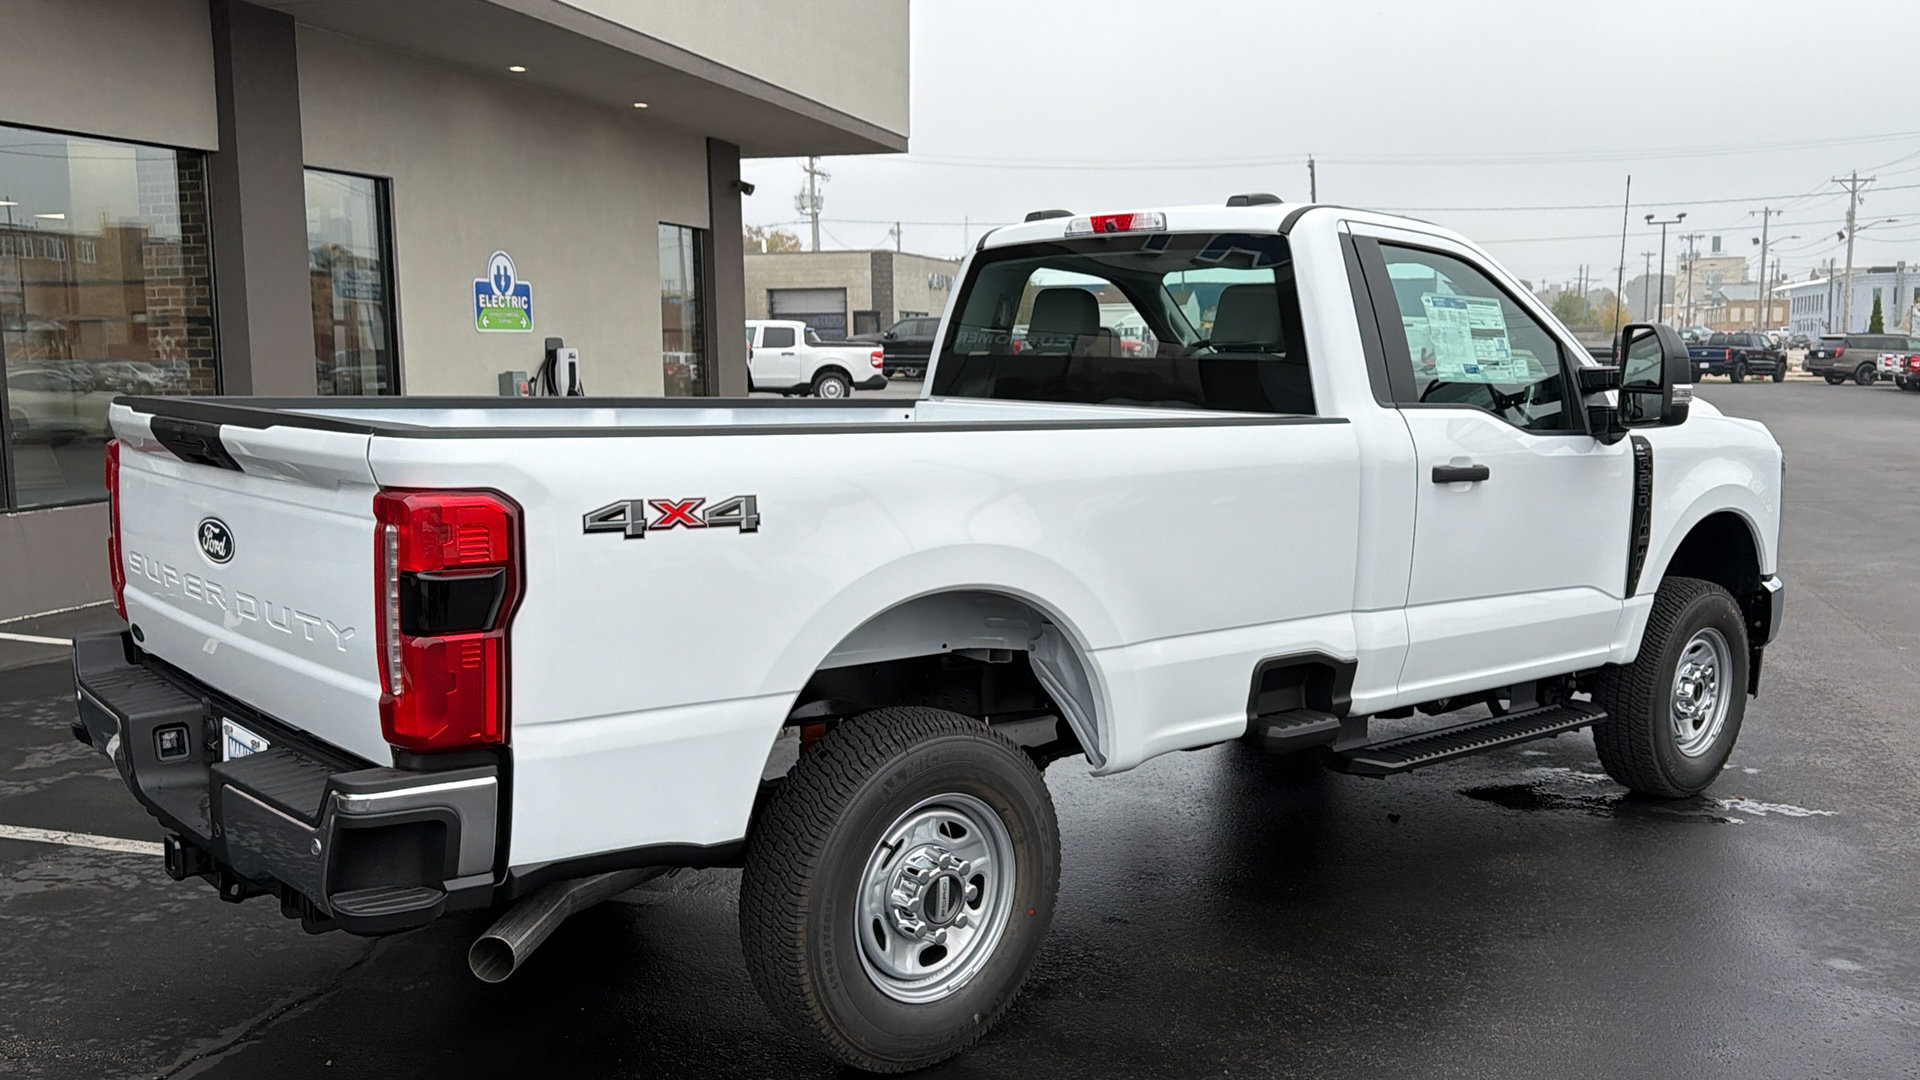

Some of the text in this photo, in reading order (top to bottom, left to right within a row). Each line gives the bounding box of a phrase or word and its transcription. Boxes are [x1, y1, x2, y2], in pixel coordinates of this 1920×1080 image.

[479, 293, 528, 309] ELECTRIC
[202, 522, 229, 557] Ford
[128, 550, 357, 653] SUPER DUTY
